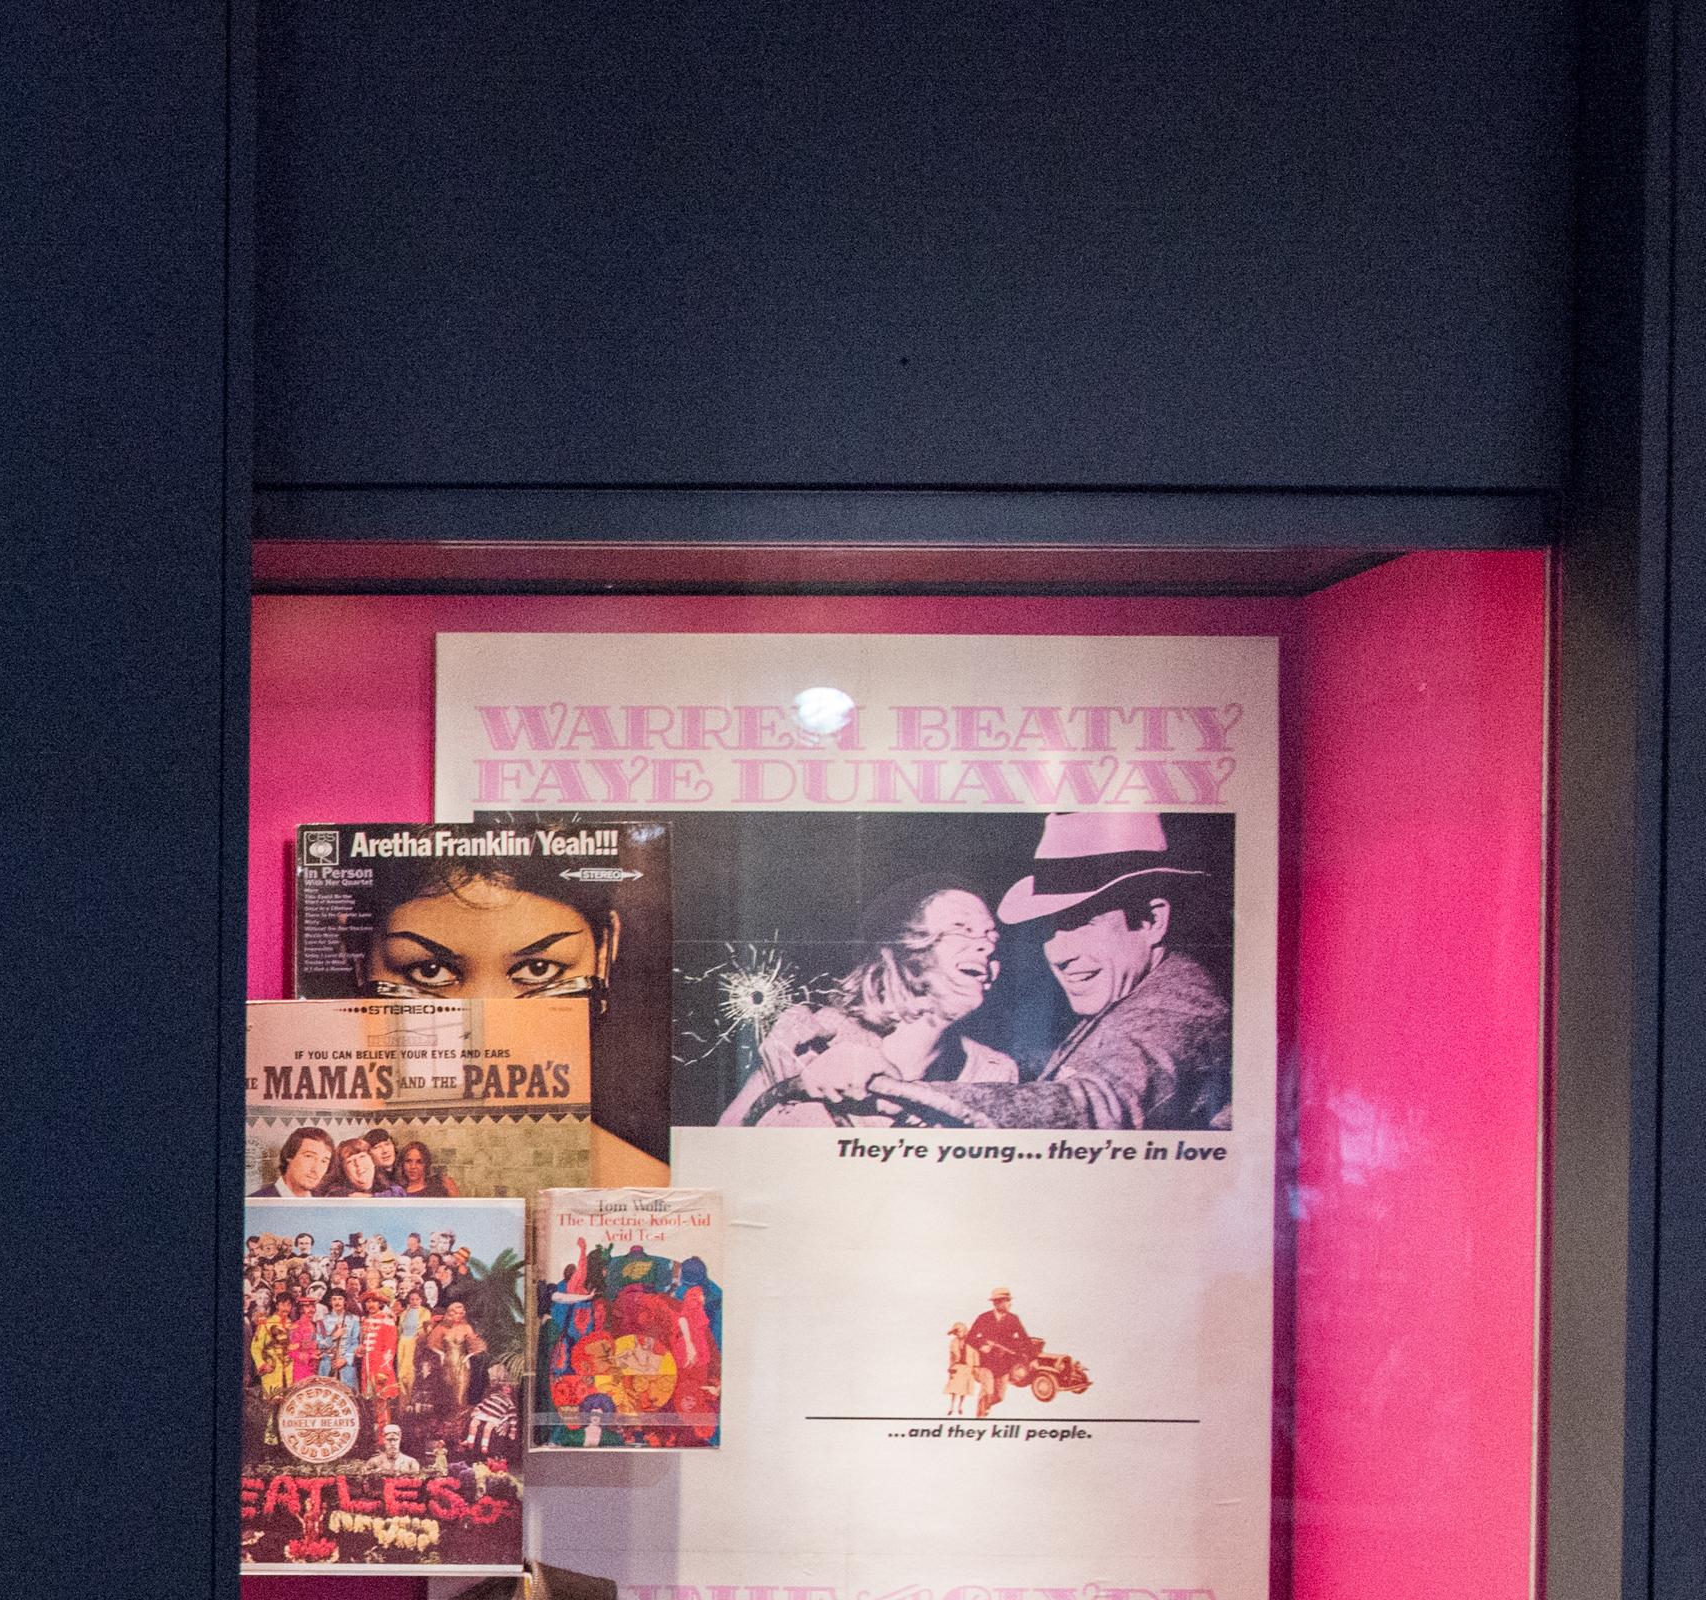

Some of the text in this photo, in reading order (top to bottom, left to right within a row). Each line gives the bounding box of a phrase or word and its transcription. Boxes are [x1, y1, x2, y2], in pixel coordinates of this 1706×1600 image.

[890, 703, 1243, 753] BEATTY
[473, 757, 1236, 806] FAYE DUNAWAY
[351, 832, 431, 858] Aretha
[295, 1049, 510, 1059] IF YOU CAN BELIEVE YOUR EYES AND EARS
[400, 1077, 426, 1089] AND
[432, 1076, 457, 1088] THE
[1144, 1141, 1168, 1160] in
[1174, 1141, 1227, 1162] love
[598, 1200, 671, 1213] Tom Wolfe
[559, 1214, 710, 1227] The Electric Kool-Aid
[602, 1230, 665, 1241] Acid Test
[947, 1425, 986, 1442] they
[991, 1426, 1020, 1440] kill
[1026, 1427, 1092, 1443] people.
